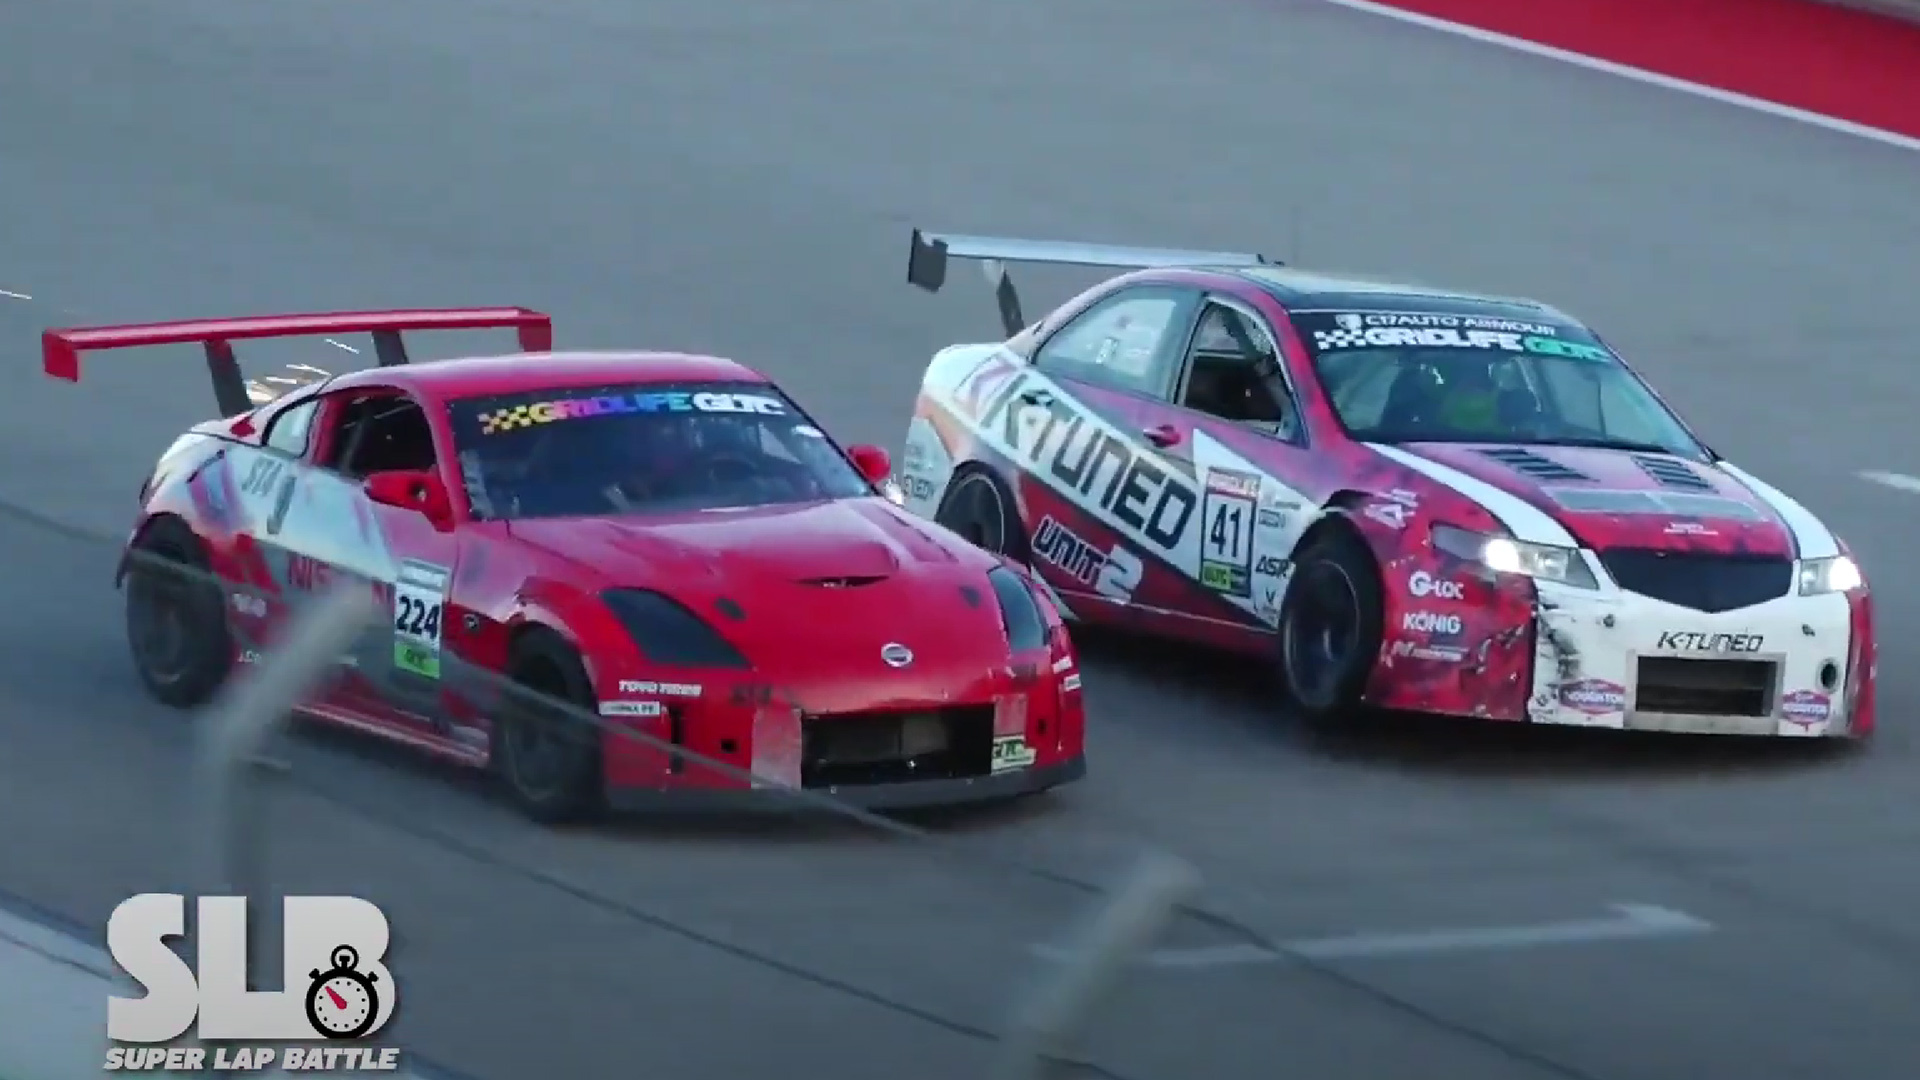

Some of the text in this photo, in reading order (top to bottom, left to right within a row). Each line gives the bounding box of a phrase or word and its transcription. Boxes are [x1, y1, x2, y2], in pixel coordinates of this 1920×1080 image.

[1364, 327, 1524, 352] GRIDLIFE
[528, 393, 692, 424] GRIDLIFE
[1211, 503, 1241, 557] 41
[1409, 570, 1464, 599] G-LOC
[396, 595, 440, 640] 224
